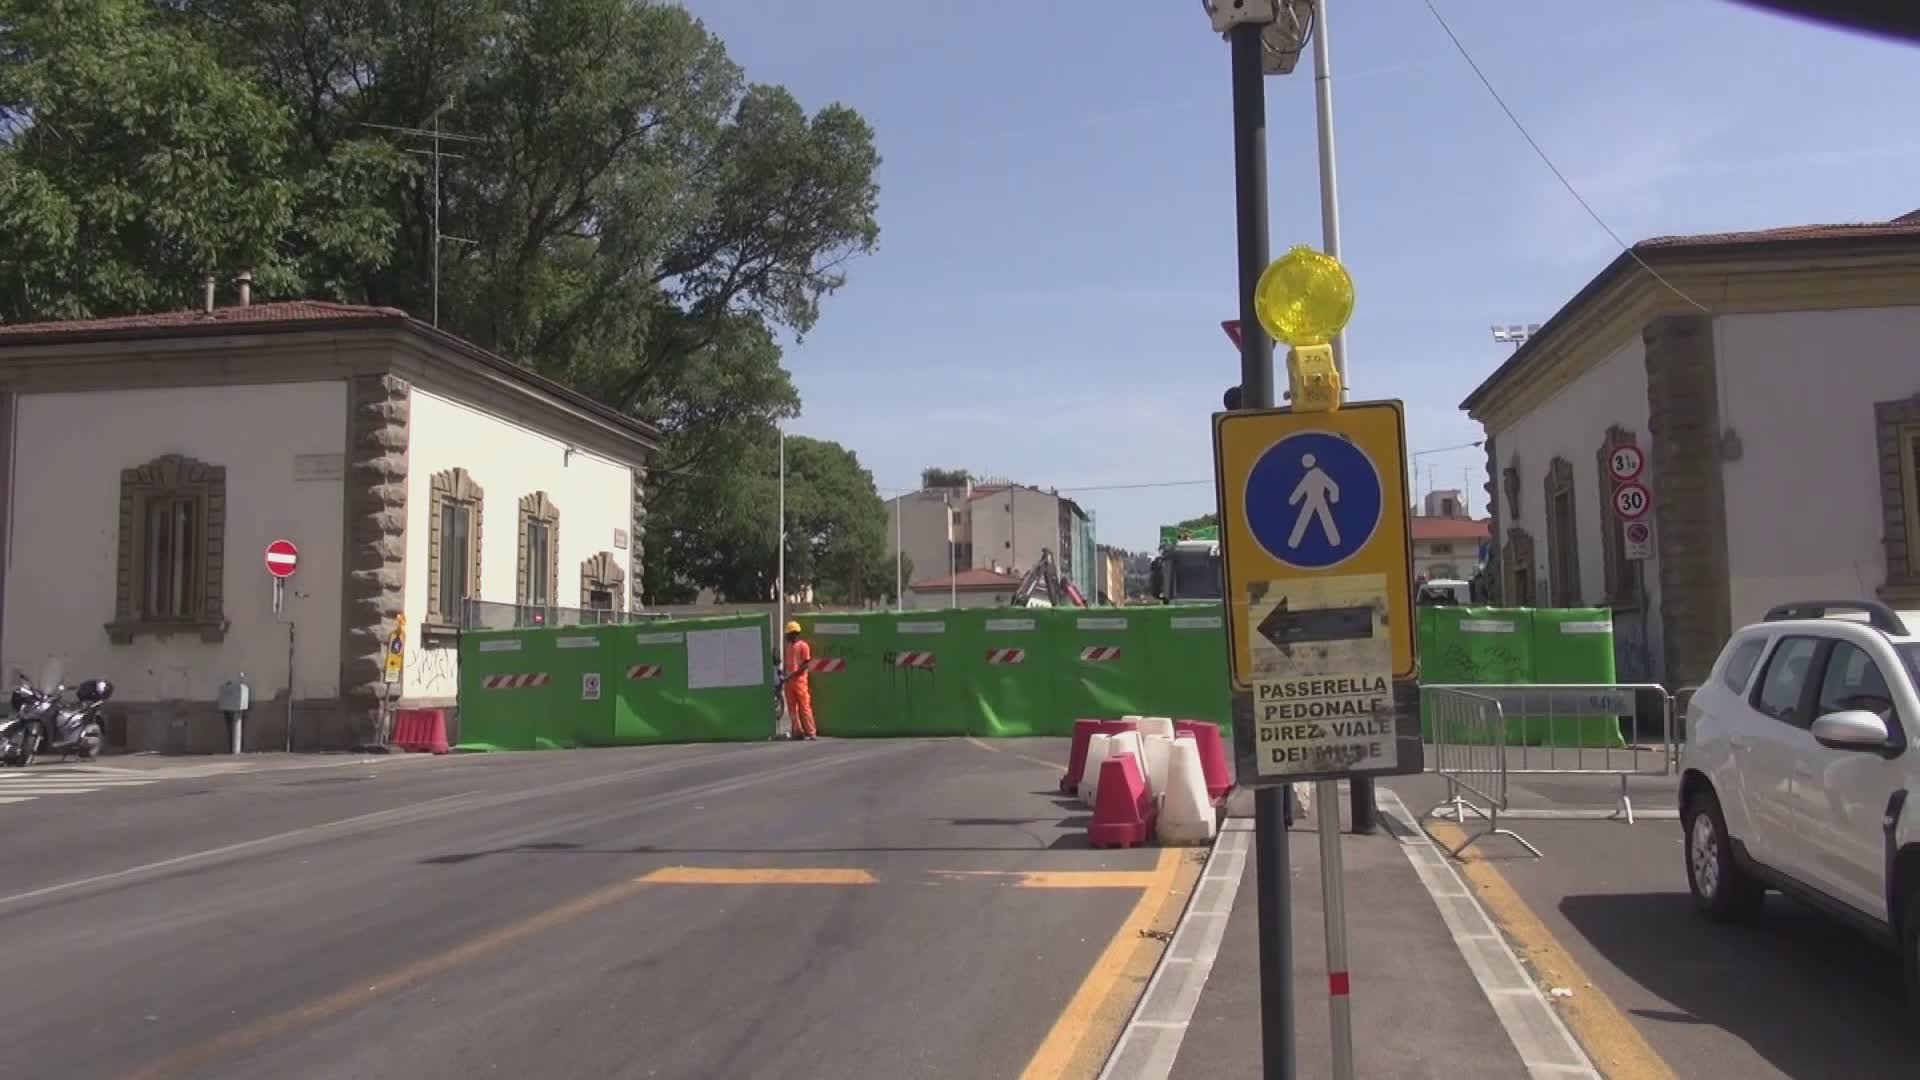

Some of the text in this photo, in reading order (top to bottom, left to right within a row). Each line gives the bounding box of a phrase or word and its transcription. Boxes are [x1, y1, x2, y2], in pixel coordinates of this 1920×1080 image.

[1621, 491, 1643, 511] 30
[1259, 676, 1387, 699] PASSERELLA
[1264, 698, 1385, 720] PEDONALE
[1331, 719, 1392, 738] VIALE
[1272, 742, 1382, 763] DEI MIE
